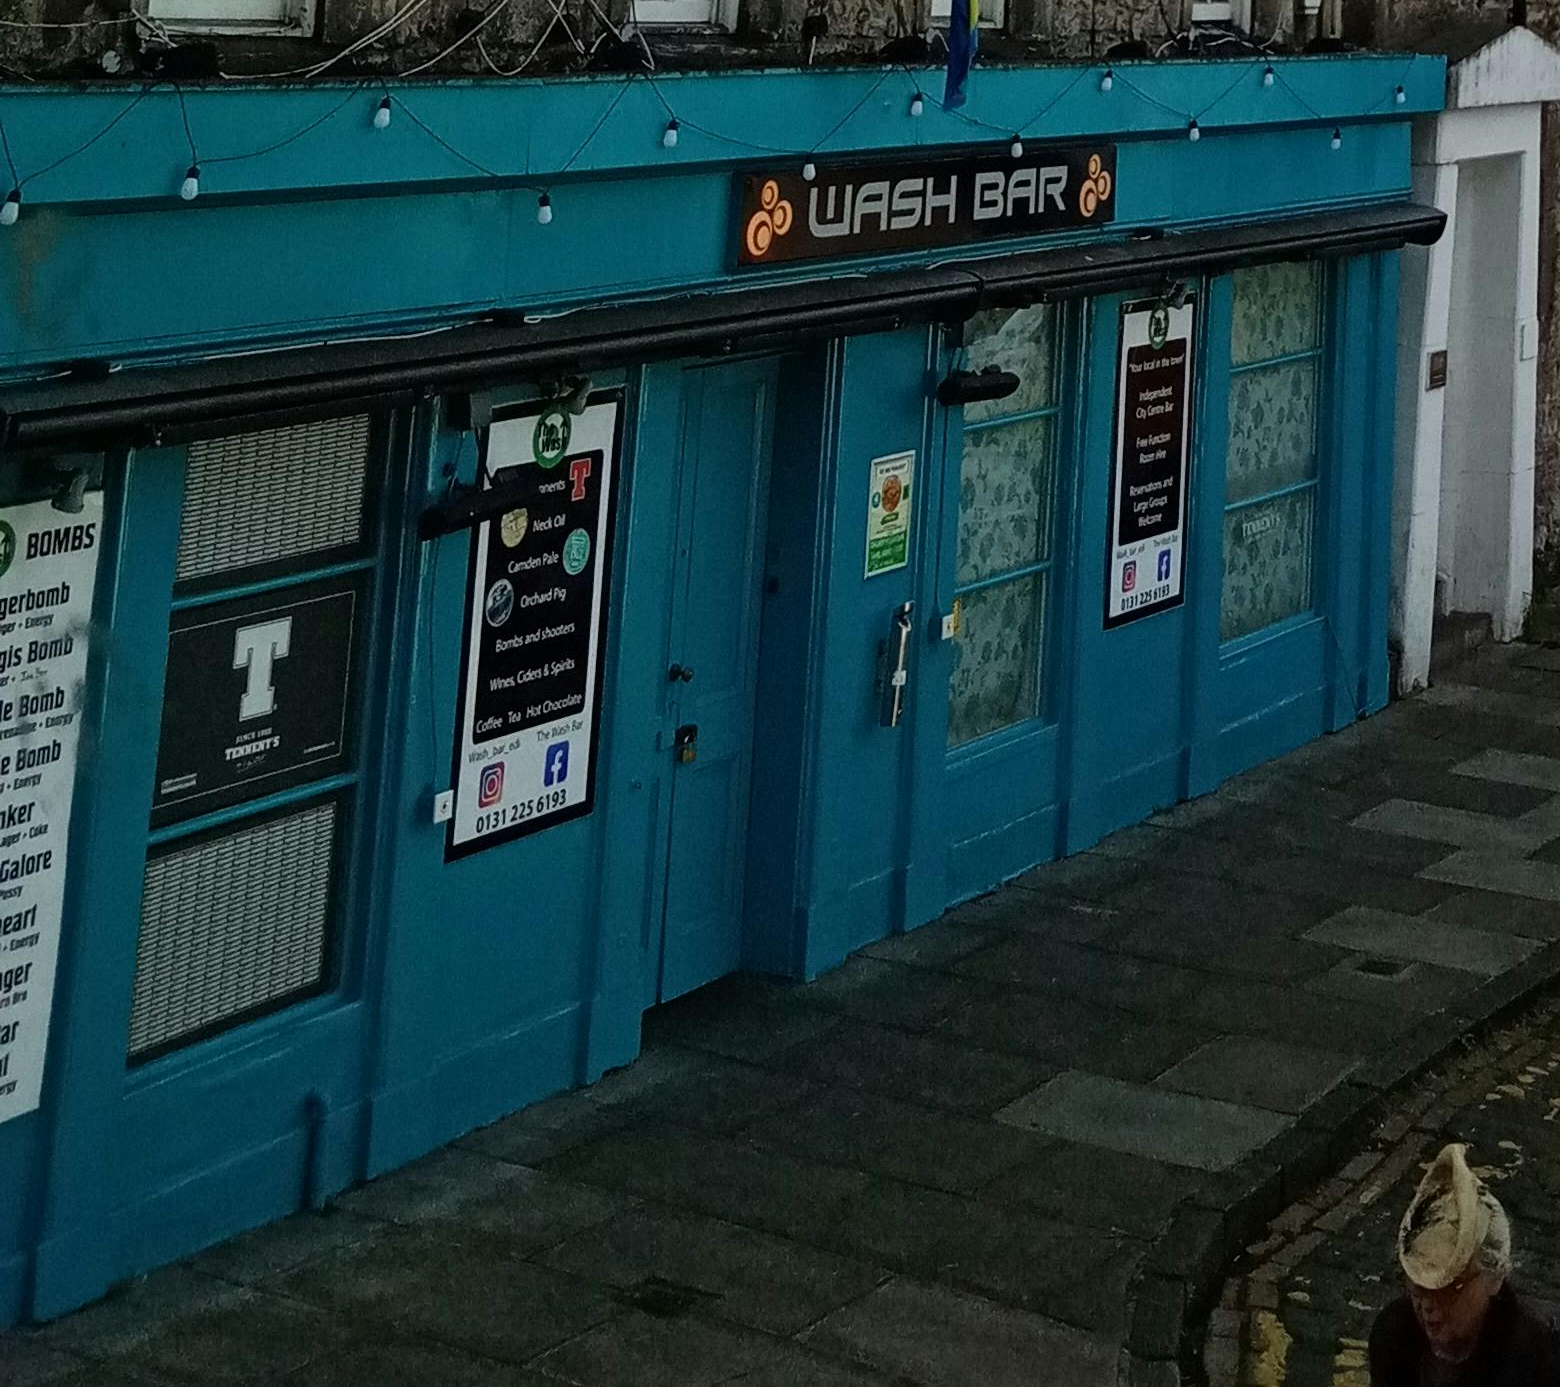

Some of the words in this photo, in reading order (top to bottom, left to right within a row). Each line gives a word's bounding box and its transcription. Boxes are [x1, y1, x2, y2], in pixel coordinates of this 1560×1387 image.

[808, 175, 957, 238] WASH
[973, 165, 1068, 220] BAR
[1139, 385, 1172, 402] Independent
[1136, 406, 1147, 419] City
[1147, 403, 1165, 417] Centre
[1165, 400, 1174, 412] Bar
[1136, 435, 1148, 449] Free
[1149, 432, 1171, 446] Function
[1156, 449, 1167, 460] Hire
[1129, 479, 1162, 497] Reservations
[1163, 475, 1174, 488] and
[1134, 500, 1148, 514] Large
[1149, 495, 1168, 509] Groups
[533, 518, 553, 533] Neck
[553, 514, 566, 528] Oil
[1138, 513, 1162, 527] Welcome
[26, 523, 96, 560] BOMBS
[508, 557, 542, 573] Camden
[543, 550, 560, 567] Pale
[520, 590, 552, 608] Orchard
[553, 587, 566, 602] Pig
[1139, 590, 1152, 606] 225
[27, 632, 74, 664] Bomb
[495, 634, 523, 653] Bombs
[525, 630, 541, 644] and
[541, 623, 576, 641] shooters
[232, 616, 292, 722] T
[517, 667, 542, 684] Ciders
[543, 664, 550, 678] &
[550, 658, 576, 677] Spirits
[19, 686, 65, 718] Bomb
[476, 717, 502, 734] Coffee
[507, 711, 521, 724] Tea
[526, 704, 541, 719] Hot
[542, 693, 582, 713] Chocolate
[536, 728, 550, 743] The
[551, 724, 570, 739] Wash
[571, 719, 584, 732] Bar
[15, 739, 62, 772] Bomb
[225, 735, 280, 761] TENNENT'S
[13, 773, 42, 791] Energy
[476, 808, 507, 834] 0131
[510, 802, 533, 823] 225
[536, 789, 567, 813] 6193
[29, 823, 49, 839] Coke
[0, 849, 52, 884] Galore
[9, 932, 40, 952] Energy
